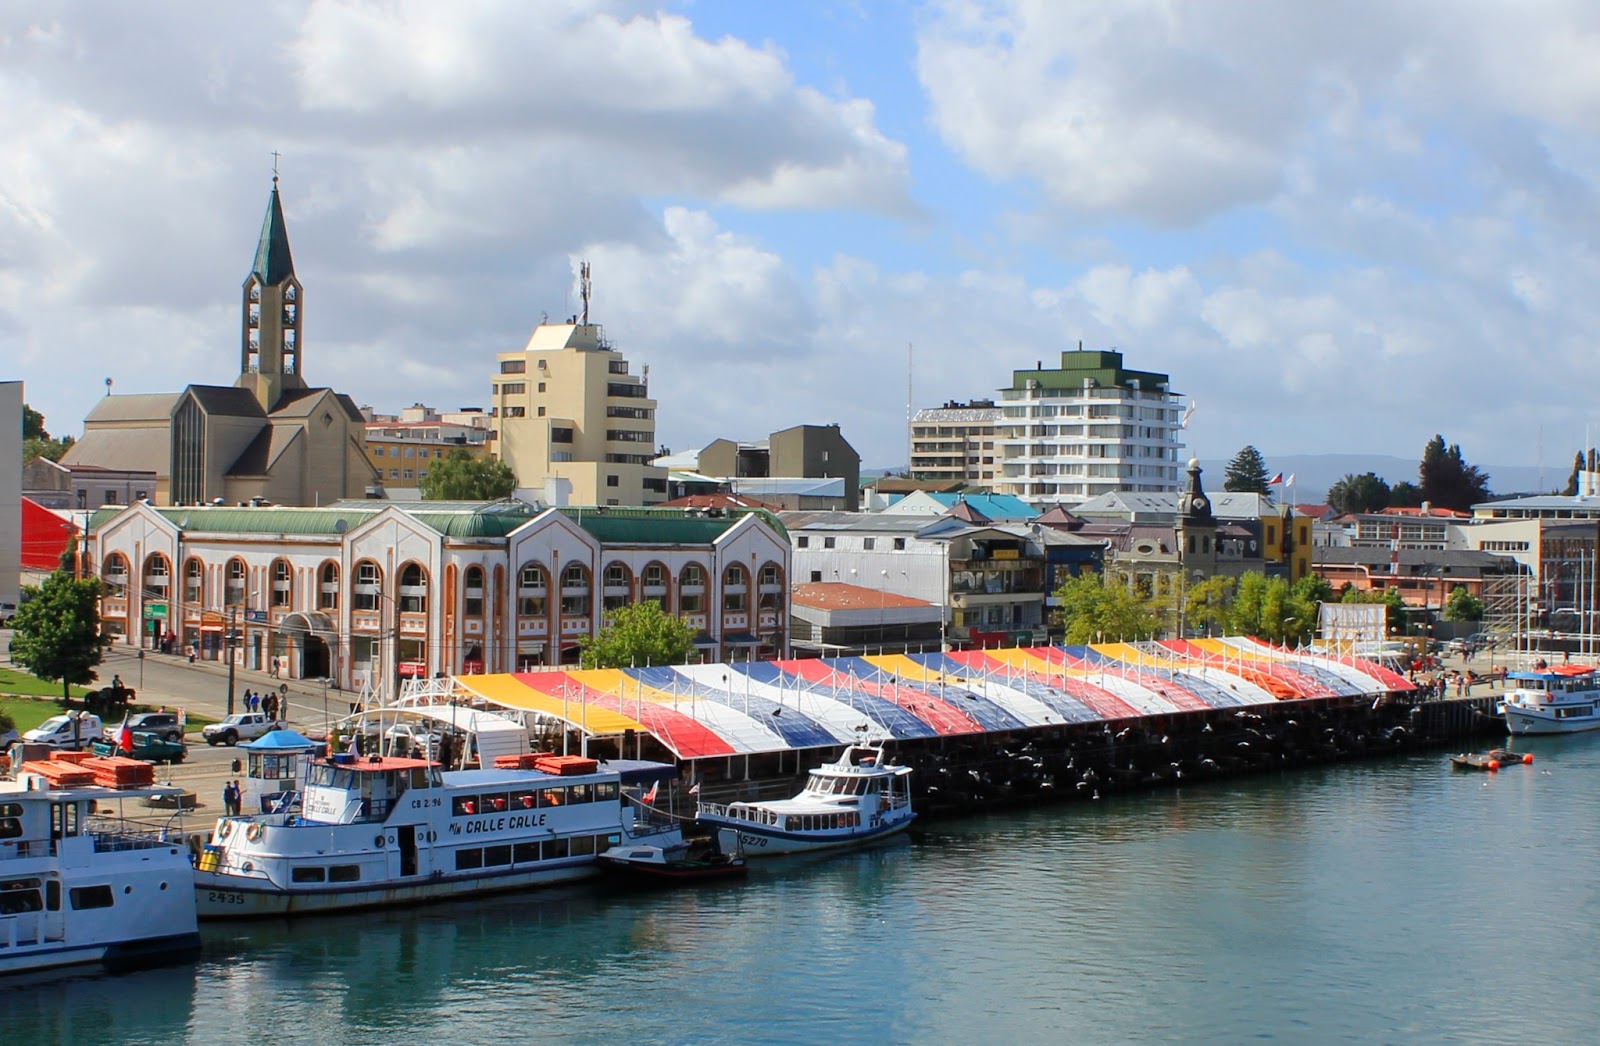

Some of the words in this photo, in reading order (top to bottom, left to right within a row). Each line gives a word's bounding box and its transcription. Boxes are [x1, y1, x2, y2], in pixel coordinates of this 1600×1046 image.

[411, 799, 421, 809] CB
[423, 797, 442, 808] 296
[466, 818, 505, 833] CALLE
[508, 813, 547, 829] CALLE
[741, 835, 769, 848] 5270
[208, 891, 245, 905] 2435
